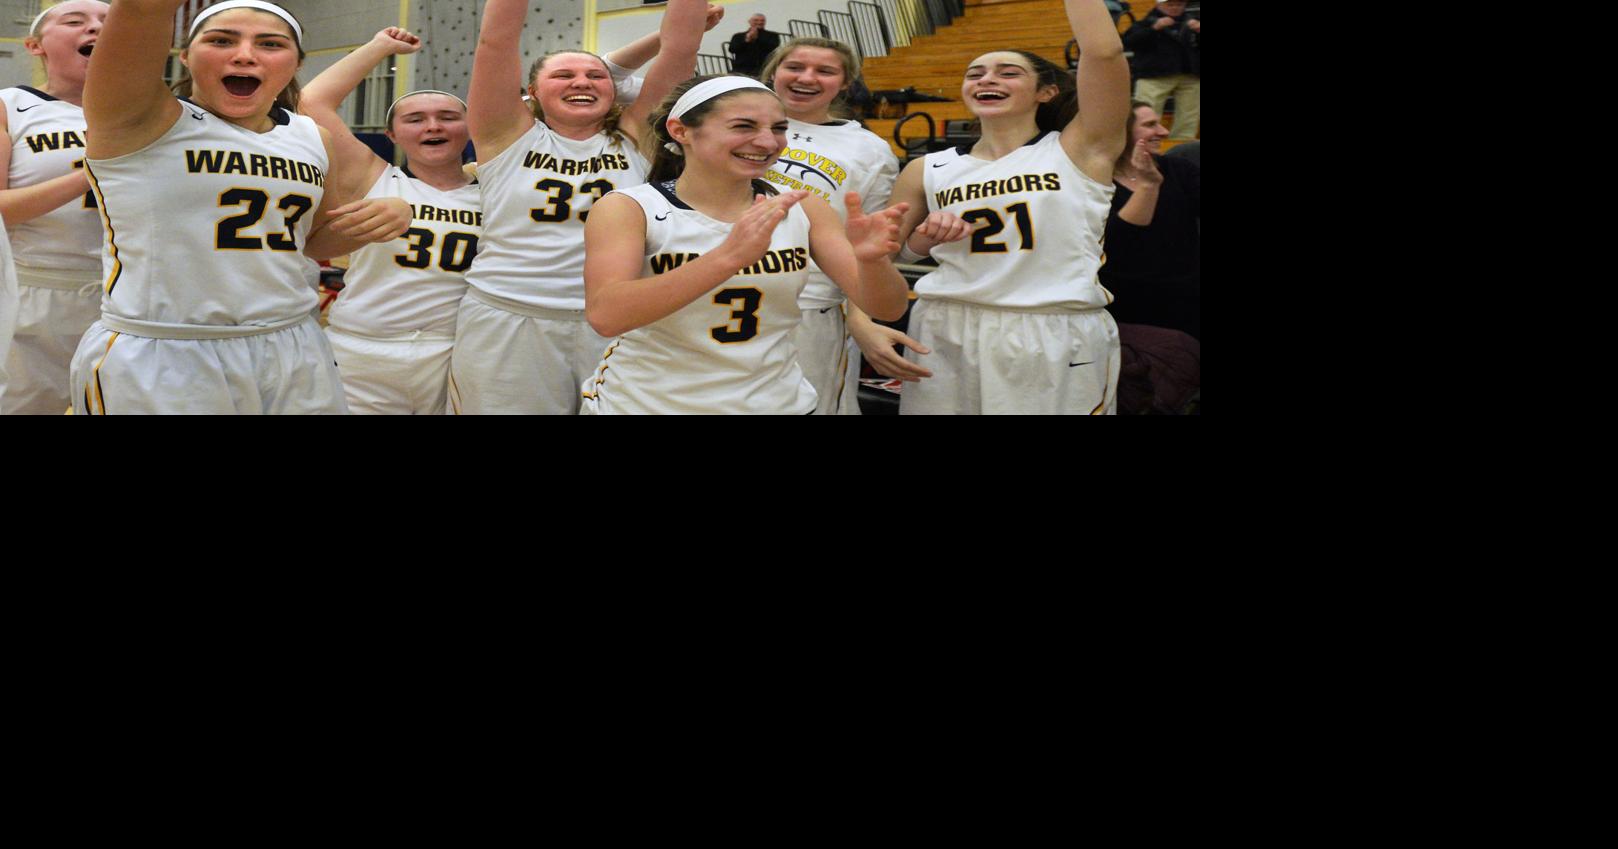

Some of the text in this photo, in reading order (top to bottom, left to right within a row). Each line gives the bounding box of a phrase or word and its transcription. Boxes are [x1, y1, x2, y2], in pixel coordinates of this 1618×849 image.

[184, 149, 326, 188] WARRIOR
[522, 150, 630, 175] WARRIORS
[934, 172, 1061, 209] WARRIORS
[213, 187, 315, 252] 23
[960, 201, 1034, 254] 21
[393, 226, 480, 272] 30
[709, 285, 764, 345] 3
